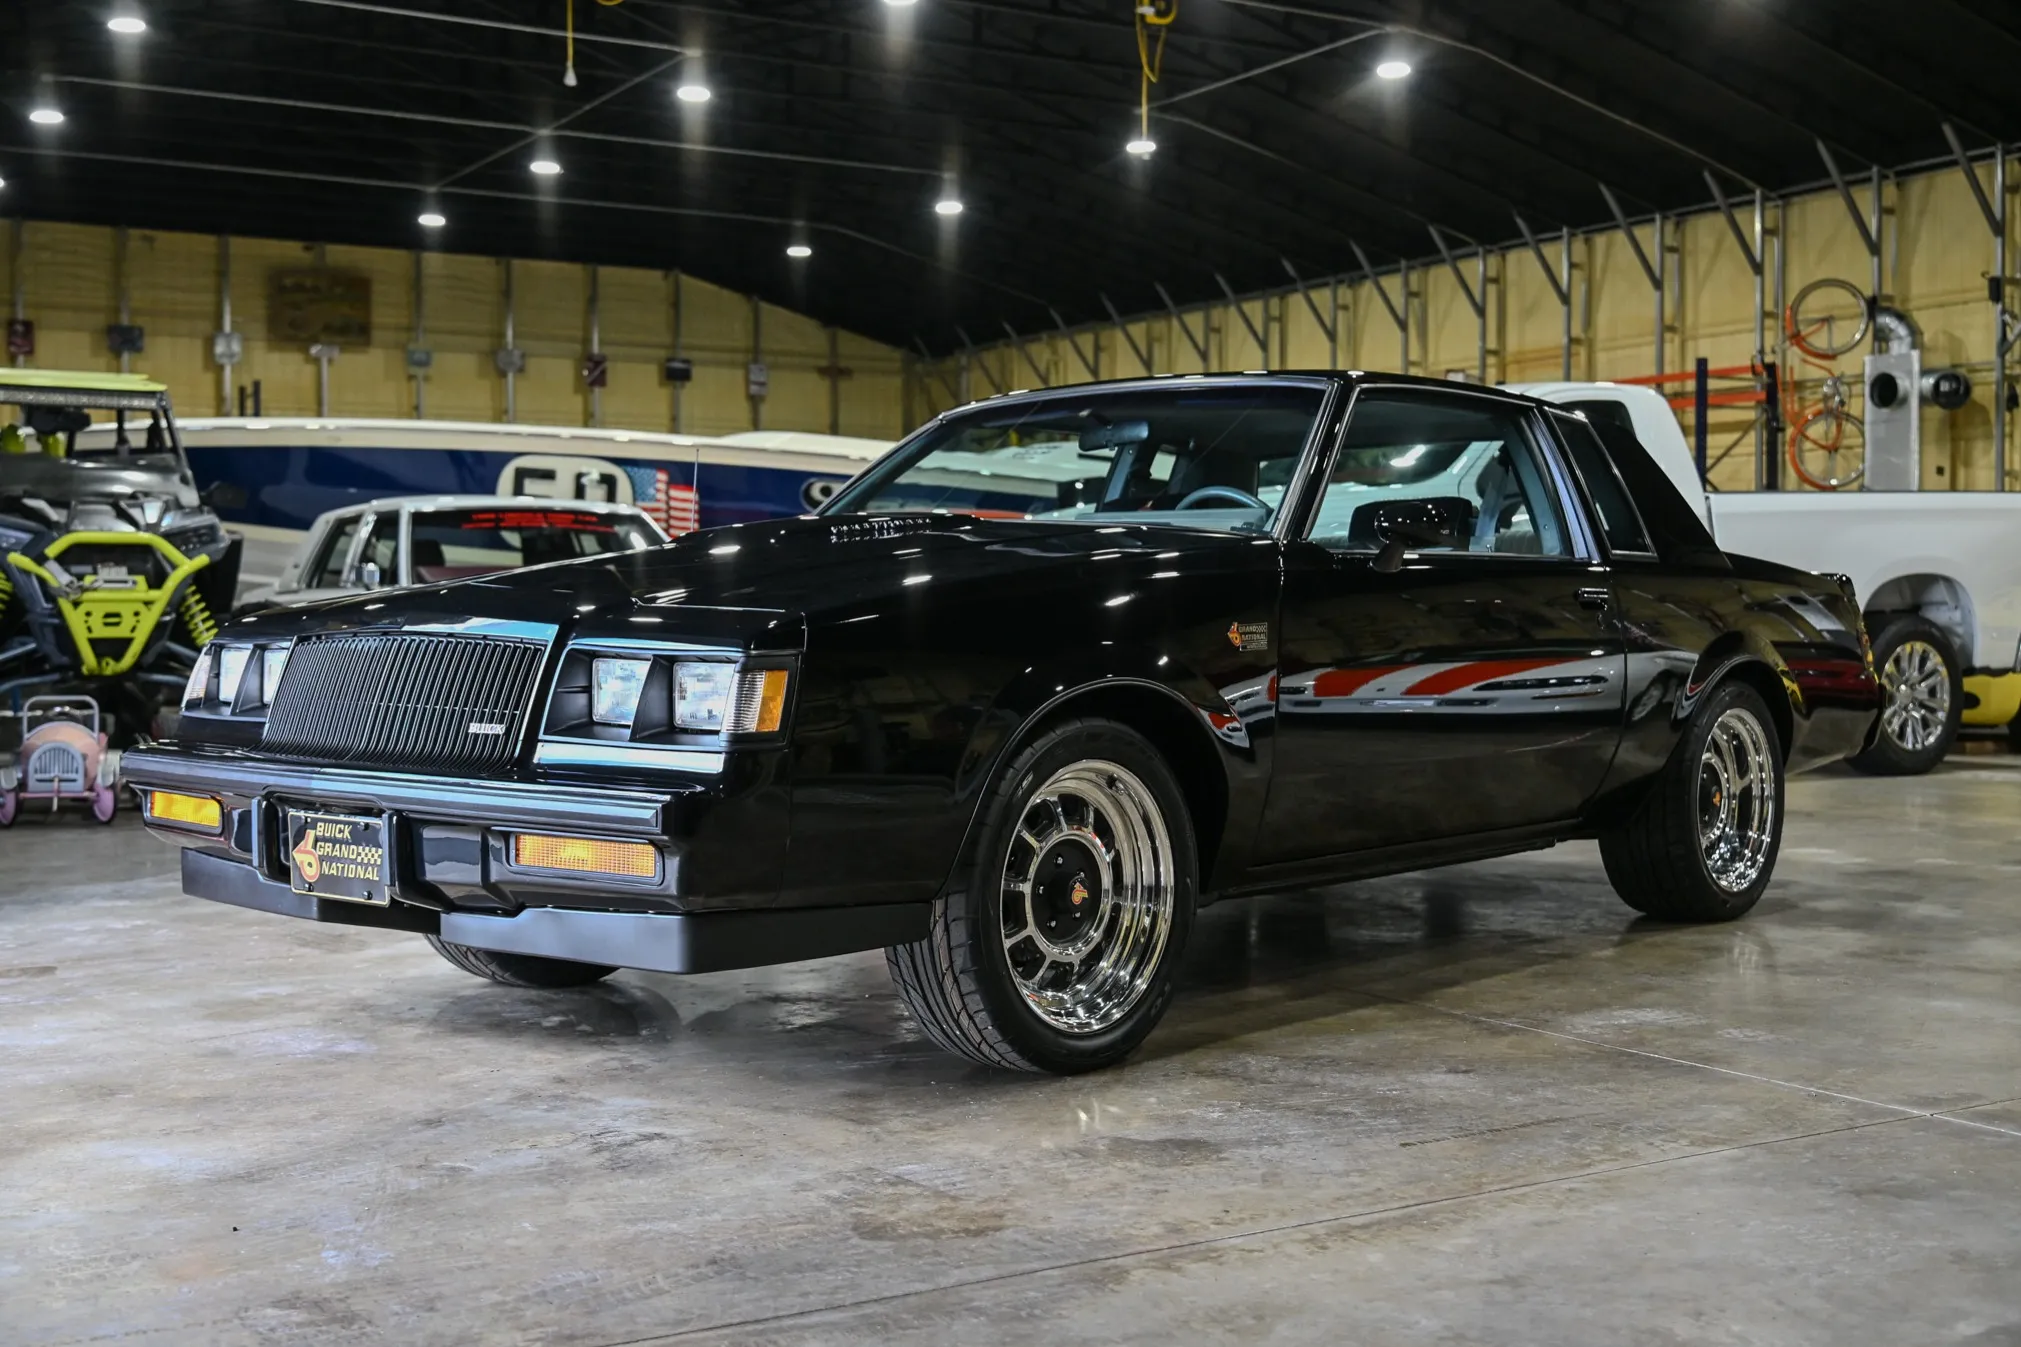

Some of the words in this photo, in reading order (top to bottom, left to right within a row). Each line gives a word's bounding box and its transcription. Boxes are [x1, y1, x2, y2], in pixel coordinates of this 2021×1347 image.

[468, 723, 506, 734] BUICK
[316, 822, 352, 840] BUICK
[316, 842, 357, 859] GRAND
[321, 861, 379, 880] NATIONAL
